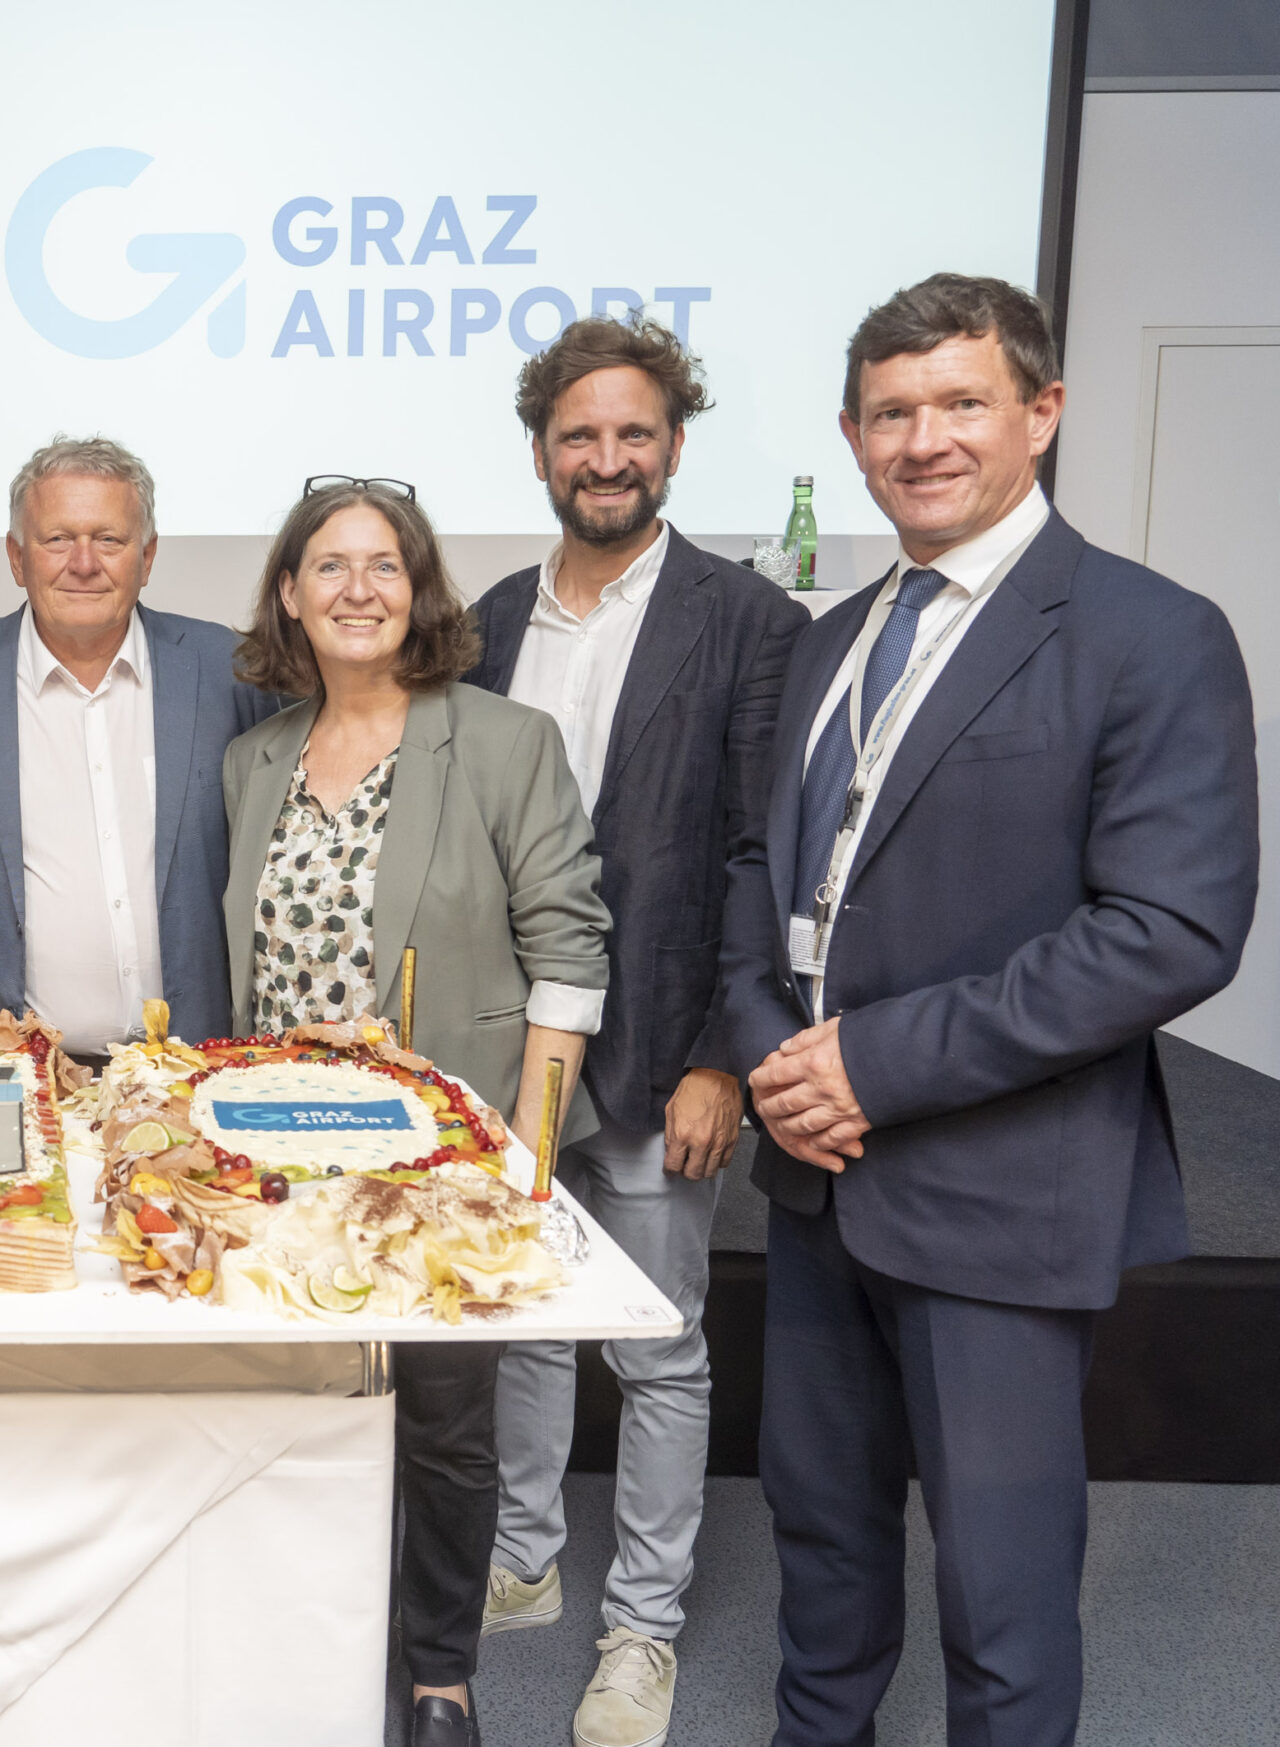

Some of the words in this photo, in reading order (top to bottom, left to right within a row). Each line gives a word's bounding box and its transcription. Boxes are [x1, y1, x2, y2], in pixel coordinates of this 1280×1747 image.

[272, 194, 538, 267] GRAZ
[292, 1110, 355, 1118] GRAZ
[296, 1116, 394, 1125] AIRPORT
